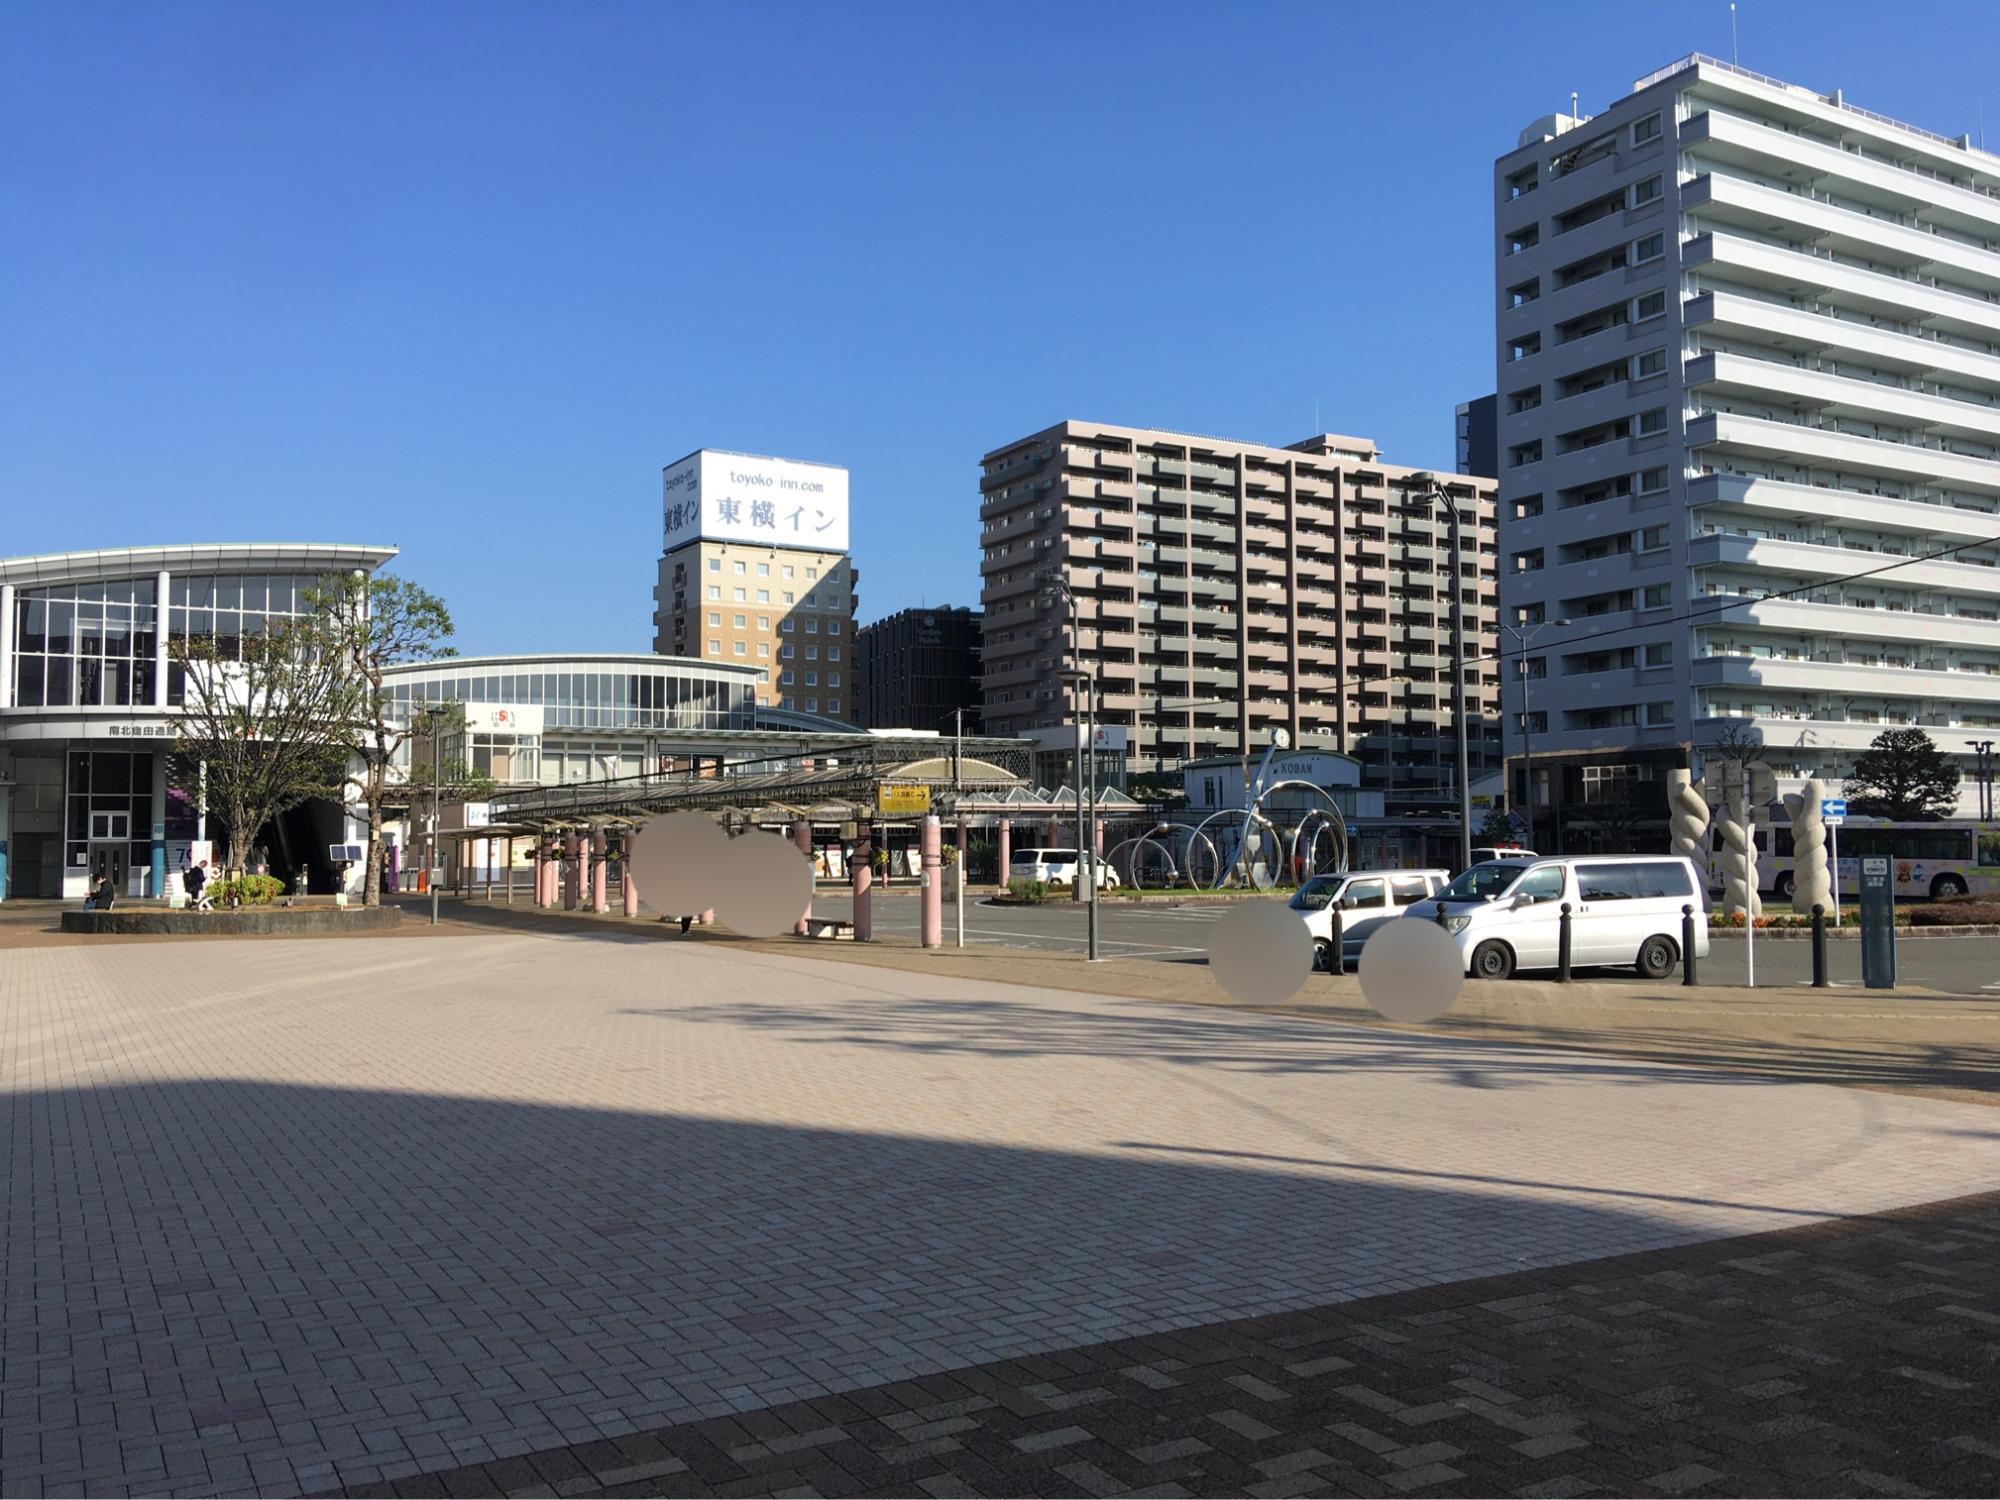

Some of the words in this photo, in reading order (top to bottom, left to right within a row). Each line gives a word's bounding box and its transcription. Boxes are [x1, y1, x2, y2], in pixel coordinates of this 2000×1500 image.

[717, 496, 836, 533] 東横イン
[1281, 763, 1312, 774] KOBAN
